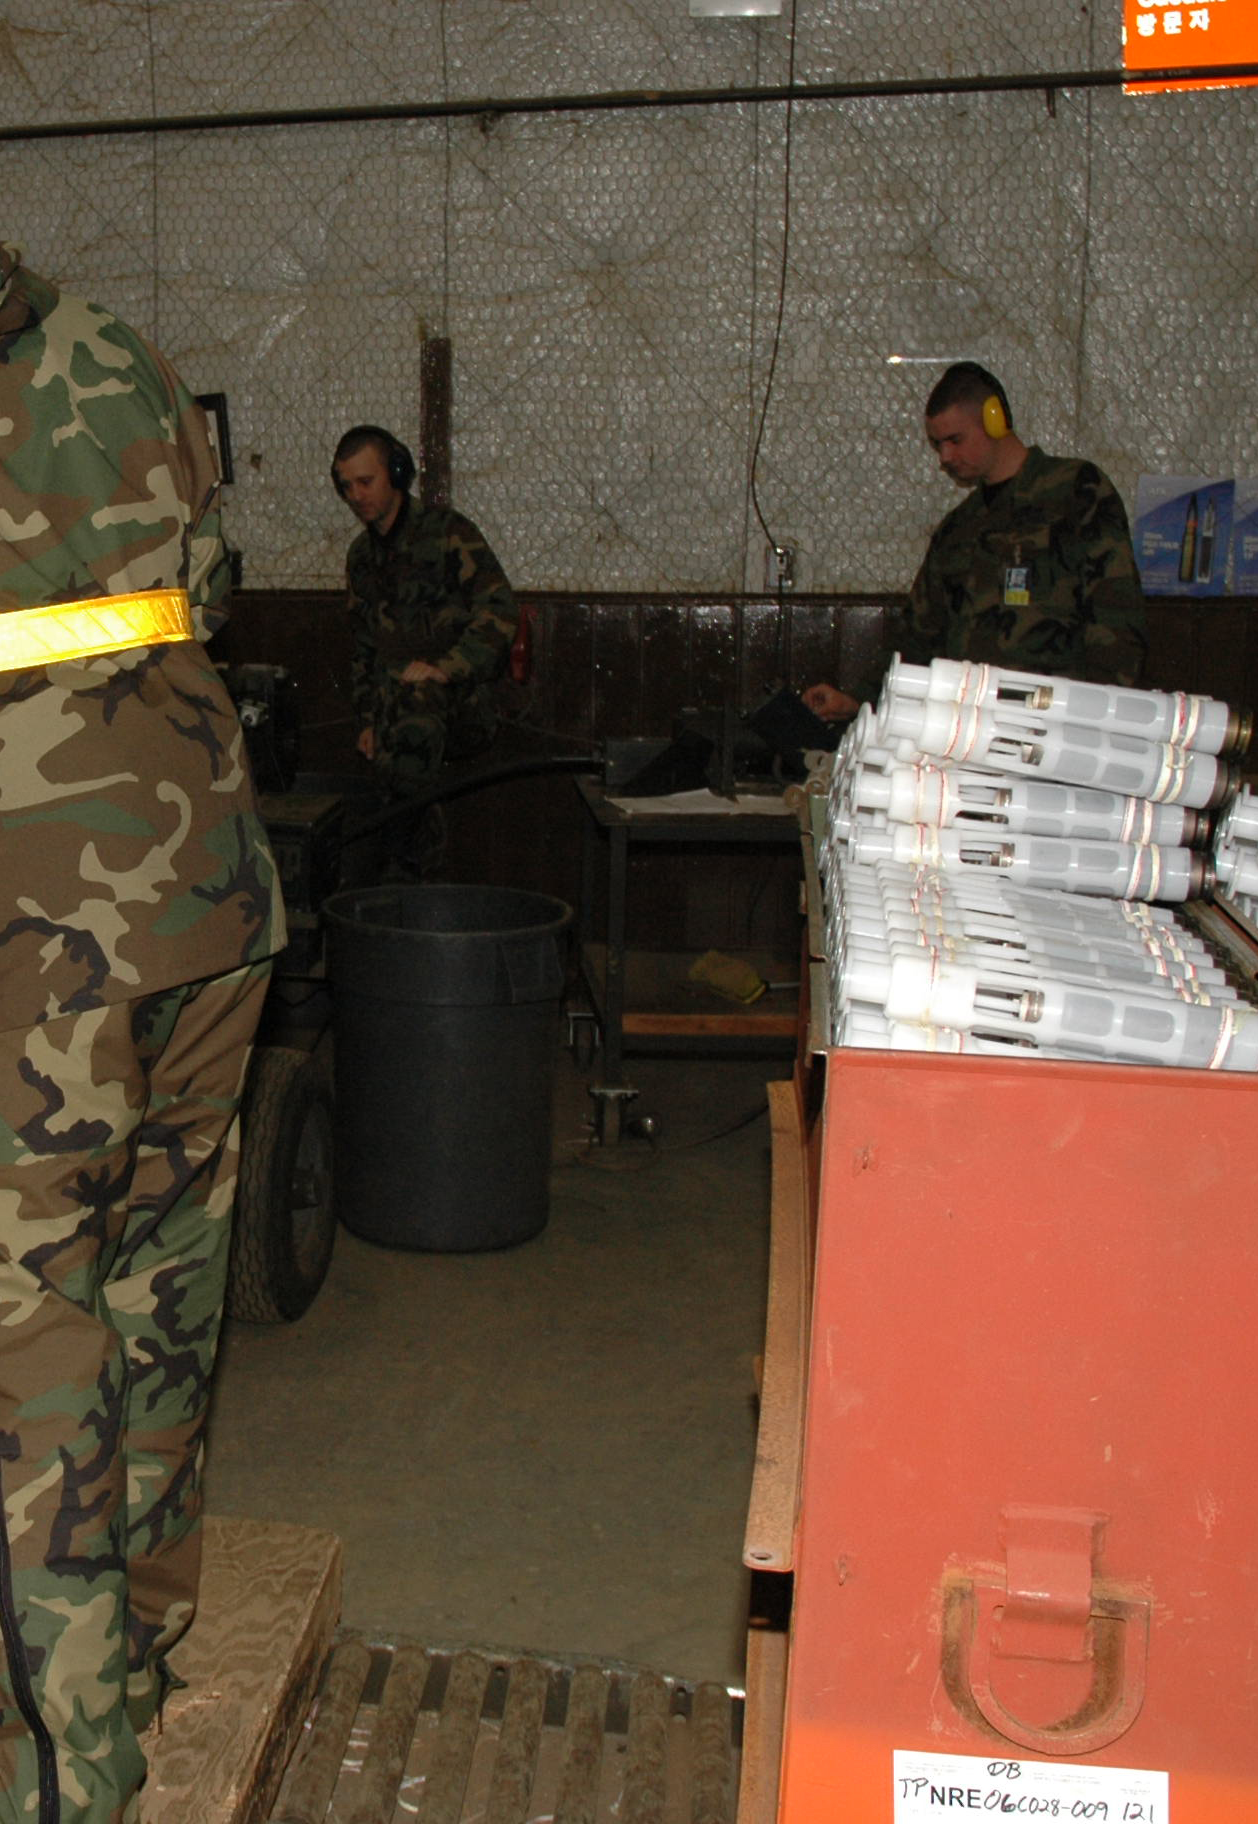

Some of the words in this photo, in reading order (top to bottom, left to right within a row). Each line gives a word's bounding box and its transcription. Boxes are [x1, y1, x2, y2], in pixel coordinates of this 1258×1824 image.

[987, 1761, 1021, 1780] DB
[899, 1777, 929, 1799] TP
[1123, 1802, 1154, 1823] 121
